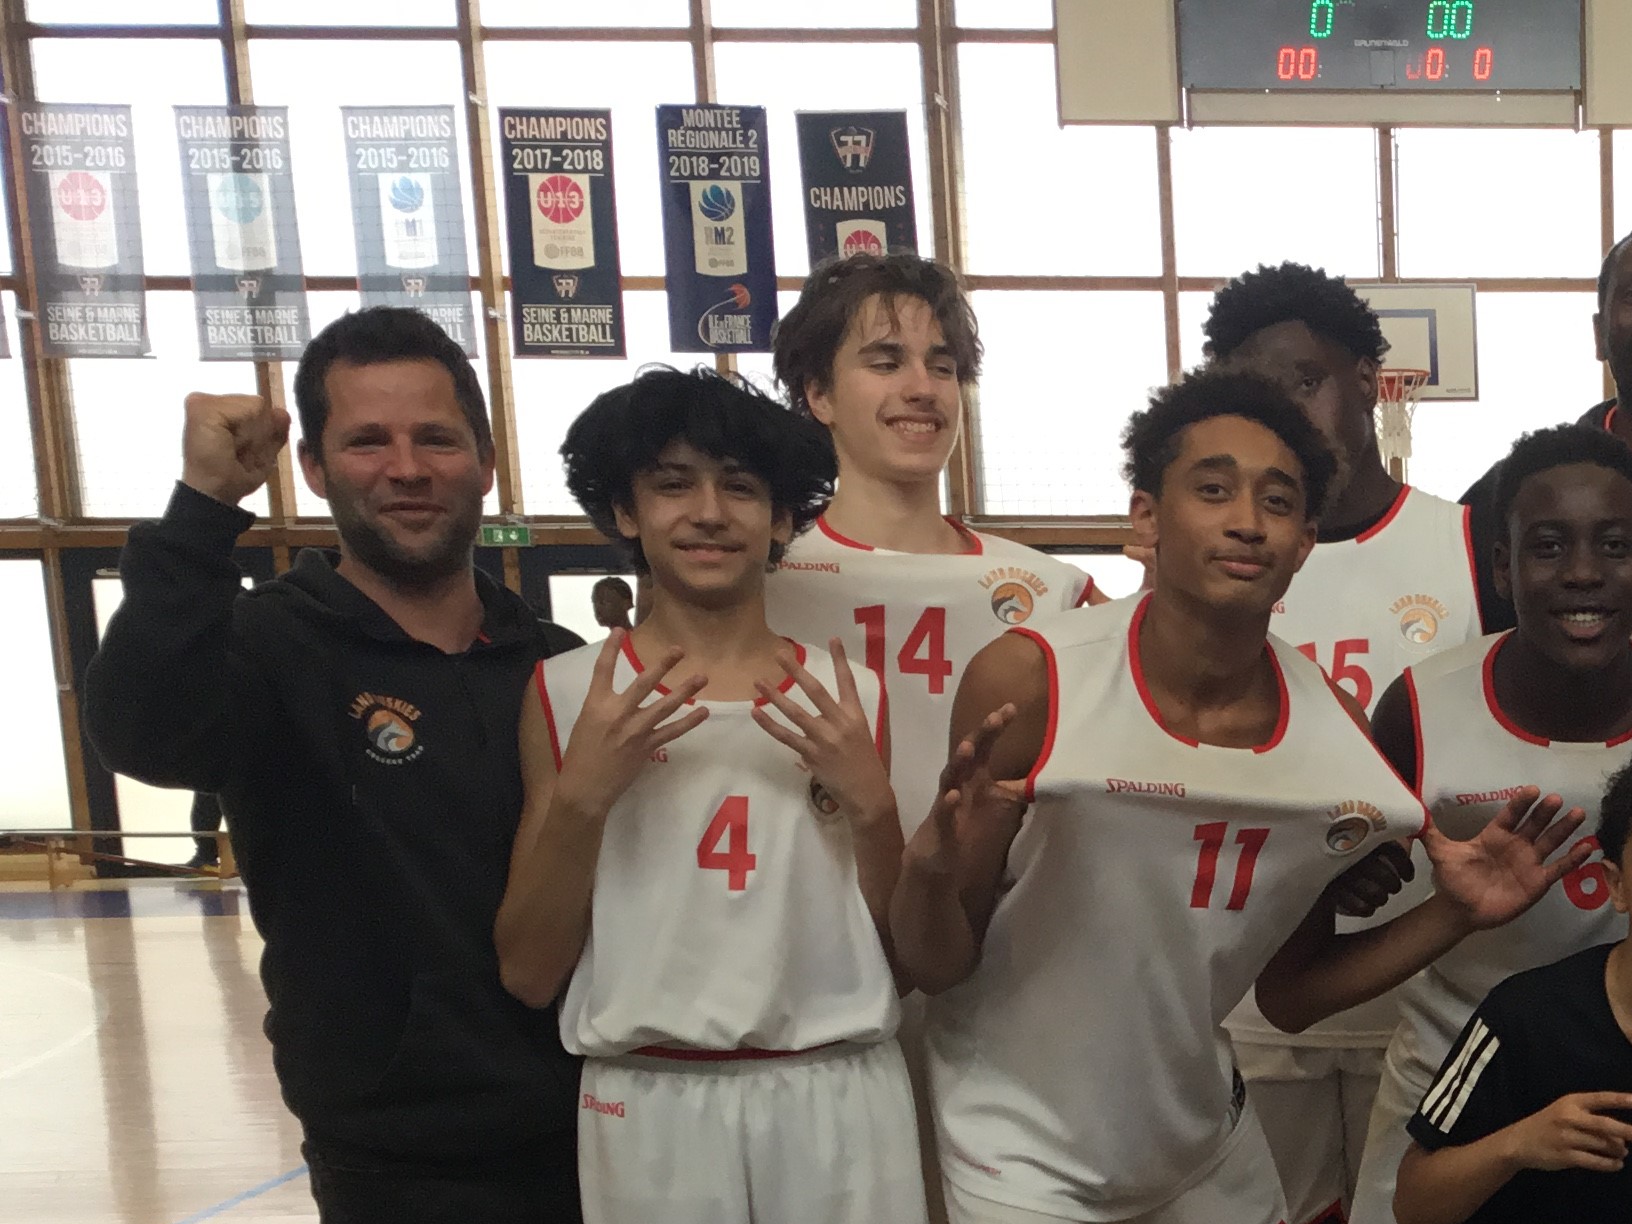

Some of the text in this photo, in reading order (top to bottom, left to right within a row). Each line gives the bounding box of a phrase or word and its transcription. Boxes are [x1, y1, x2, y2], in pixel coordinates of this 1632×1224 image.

[22, 112, 127, 137] CHAMPIONS
[180, 115, 284, 139] CHAMPIONS
[347, 115, 451, 139] CHAMPIONS
[504, 116, 607, 140] CHAMPIONS
[681, 107, 741, 128] MONTÉE
[667, 126, 758, 148] RÉGIONALE 2
[31, 144, 126, 167] 2015-2016
[188, 147, 283, 169] 2015-2016
[356, 147, 450, 169] 2015-2016
[512, 148, 604, 170] 2017-2018
[669, 156, 760, 177] 2018-2019
[540, 191, 580, 209] U13
[810, 185, 906, 211] CHAMPIONS
[47, 306, 82, 321] SEINE
[97, 306, 140, 323] MARNE
[205, 308, 298, 325] SEINE & MARNE
[522, 307, 613, 324] SEINE & MARNE
[49, 322, 141, 341] BASKETBALL
[207, 325, 301, 344] BASKETBALL
[523, 324, 615, 343] BASKETBALL
[778, 560, 840, 574] PALDING
[853, 604, 952, 694] 14
[1106, 778, 1186, 798] SPALDING
[697, 796, 756, 891] 4
[1189, 821, 1271, 910] 11
[1563, 835, 1612, 910] 6
